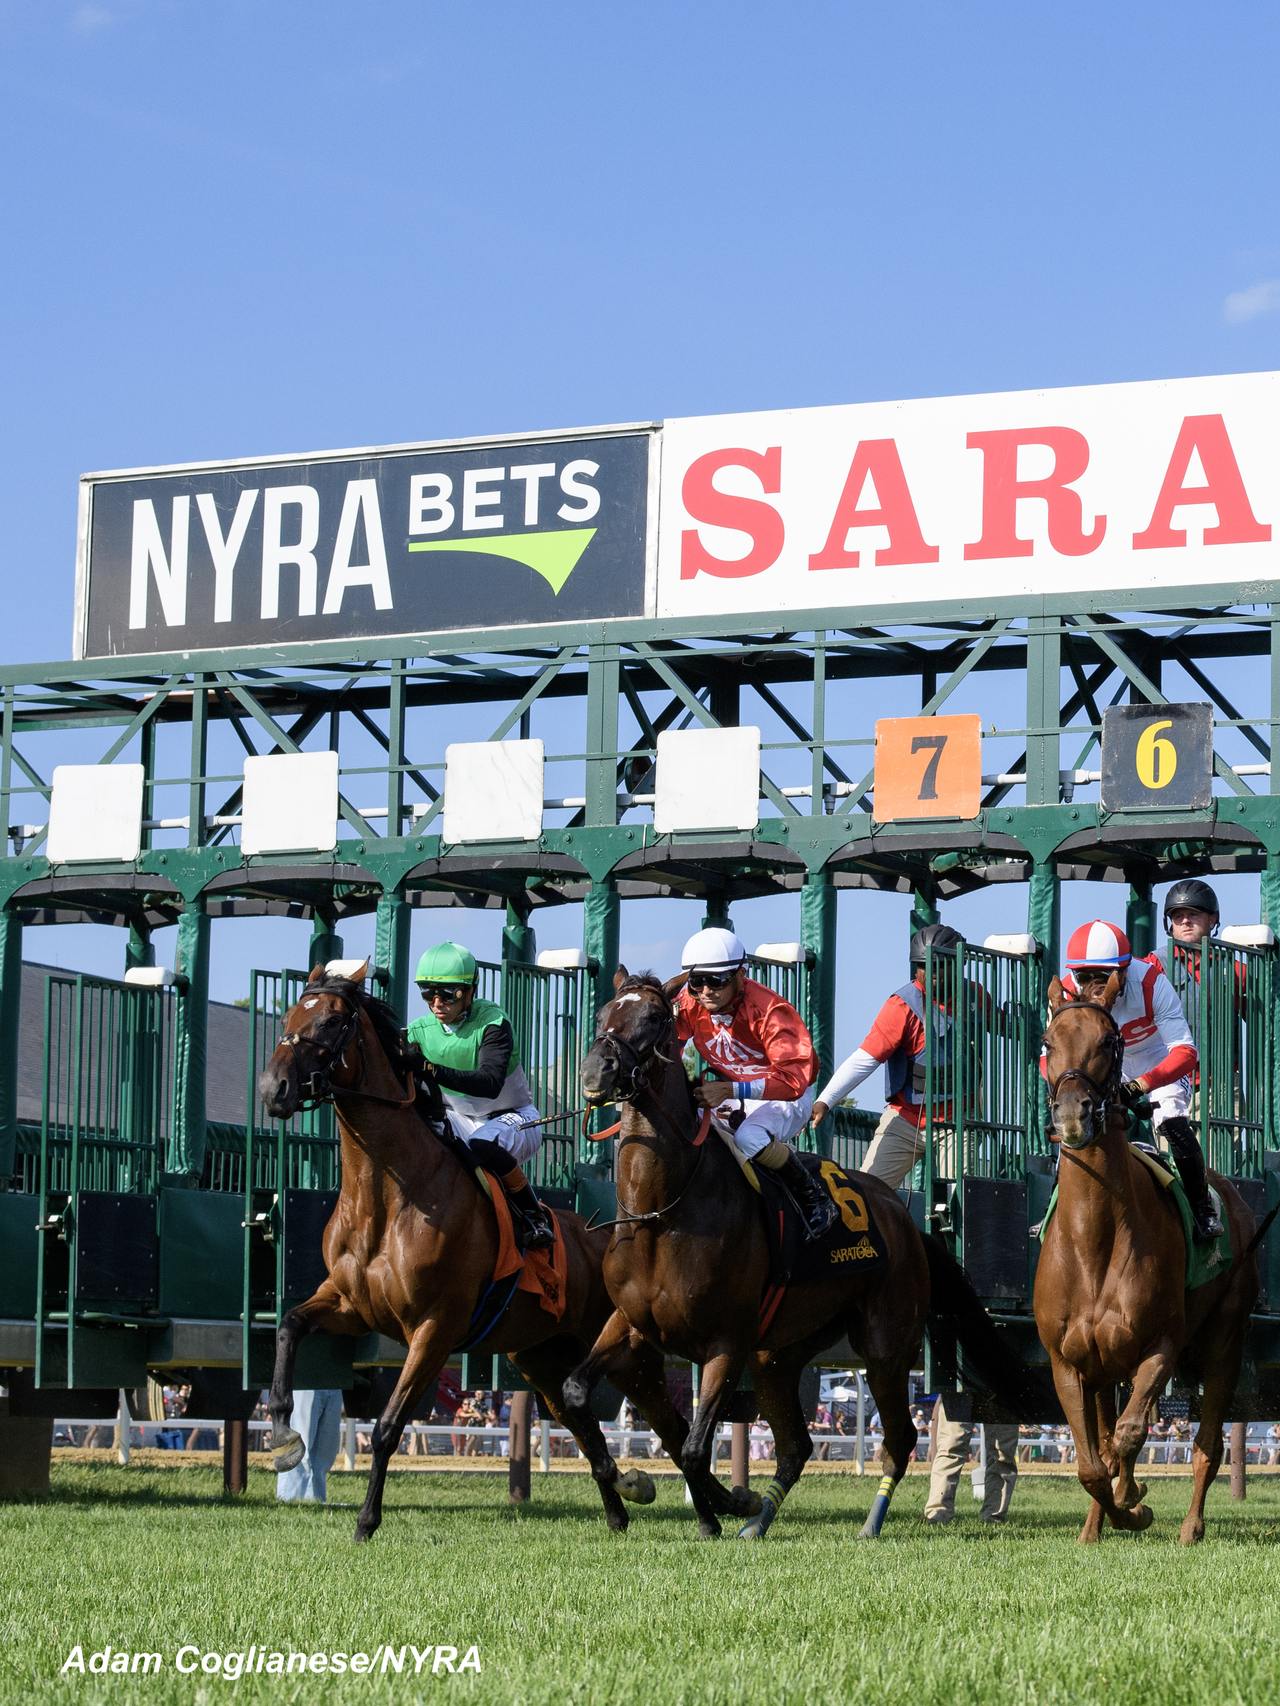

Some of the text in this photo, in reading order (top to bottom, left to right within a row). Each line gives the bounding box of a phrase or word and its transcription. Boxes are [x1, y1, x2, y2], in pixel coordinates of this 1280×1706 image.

[129, 459, 601, 630] NYRA BETS
[910, 735, 948, 800] 7
[1135, 720, 1177, 789] 6
[819, 1160, 869, 1233] 6
[830, 1245, 879, 1263] SARATOGA
